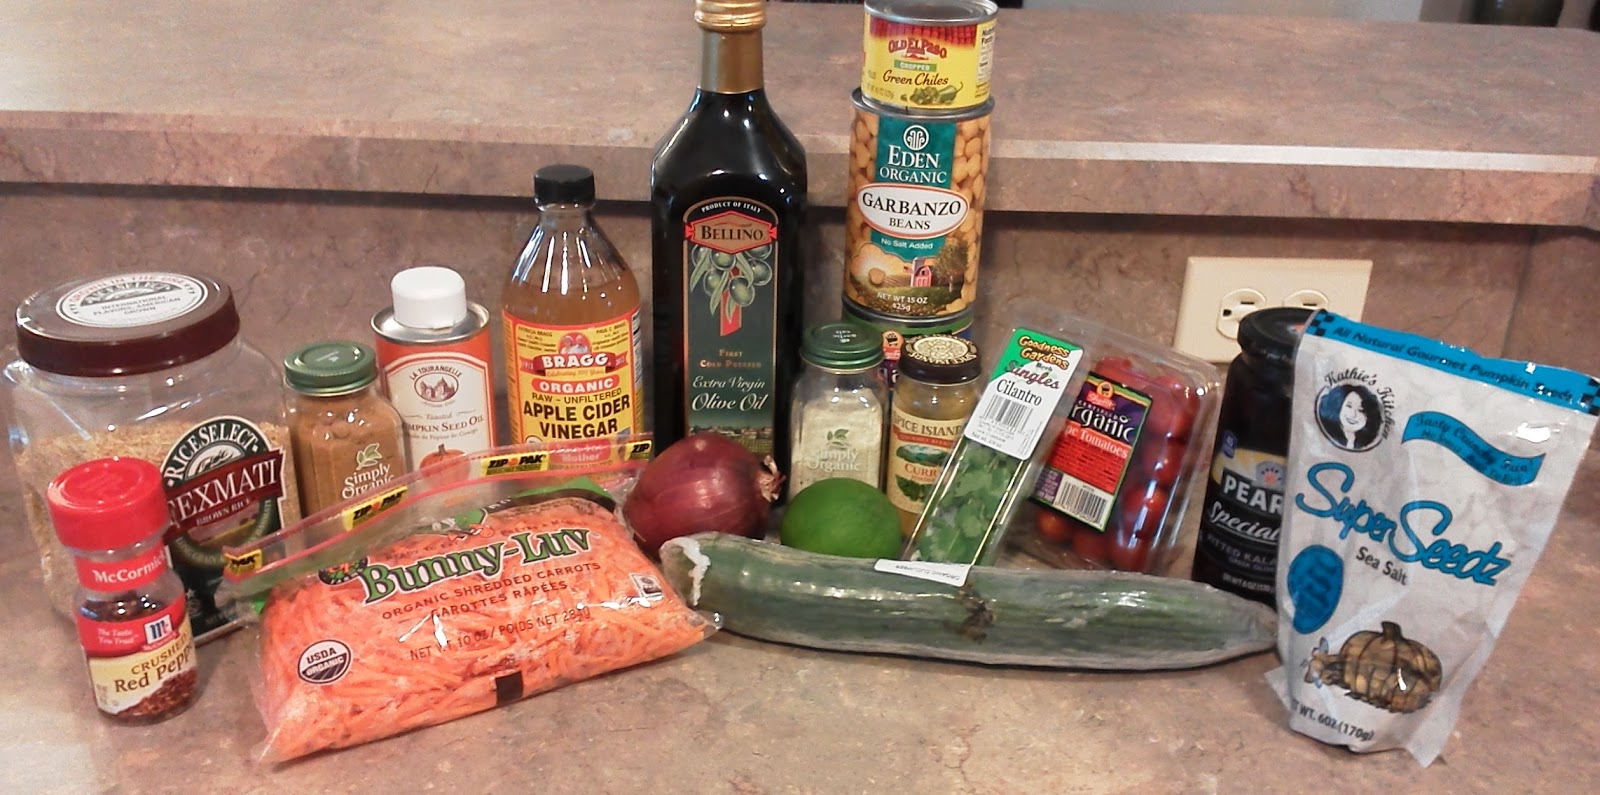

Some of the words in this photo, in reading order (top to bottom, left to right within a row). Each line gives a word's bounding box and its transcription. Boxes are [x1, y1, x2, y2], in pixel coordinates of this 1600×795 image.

[883, 69, 912, 85] Green
[914, 73, 948, 86] Chiles
[887, 144, 940, 169] EDEN
[879, 167, 947, 184] ORGANIC
[701, 202, 731, 213] PRODUCT
[743, 202, 761, 214] ITALY
[862, 192, 961, 216] GARBANZO
[701, 225, 764, 241] BELLINO
[889, 217, 931, 230] BEANS
[881, 237, 891, 246] No
[893, 240, 907, 249] Salt
[909, 241, 934, 250] Added
[877, 292, 891, 300] NET
[893, 295, 905, 303] WT
[907, 296, 916, 304] 15
[916, 297, 928, 305] OZ
[719, 349, 743, 358] FIRST
[1018, 336, 1071, 358] Goodness
[541, 353, 608, 369] BRAGG
[1020, 347, 1070, 371] Gardens
[1333, 327, 1352, 338] All
[1353, 332, 1406, 353] Natural
[1406, 346, 1467, 371] Gourmet
[1469, 364, 1529, 390] Pumpkin
[692, 375, 726, 389] Extra
[728, 376, 766, 393] Virgin
[1004, 360, 1061, 390] Singles
[531, 392, 553, 402] RAW
[564, 388, 622, 404] UNFILTERED
[539, 378, 614, 394] ORGANIC
[996, 379, 1042, 406] Cilantro
[524, 401, 577, 421] APPLE
[583, 394, 630, 420] CIDER
[691, 392, 736, 412] Olive
[739, 393, 769, 412] Oil
[1324, 367, 1378, 387] Kathie's
[1376, 386, 1396, 439] Kitchen
[402, 421, 440, 432] MPKIN
[441, 421, 468, 432] SEED
[540, 418, 618, 439] VINEGAR
[921, 425, 965, 437] ISLAND
[1071, 404, 1136, 443] rganic
[631, 443, 650, 454] ZIP
[1080, 429, 1129, 460] Tomatoes
[488, 458, 508, 469] ZIP
[518, 454, 544, 465] PAK
[807, 458, 861, 472] Organic
[905, 463, 938, 477] CURR
[344, 463, 390, 488] Simply
[1223, 474, 1284, 515] PEAR
[1210, 501, 1280, 541] Special
[1295, 462, 1397, 540] Super
[1389, 500, 1511, 587] Seedz
[362, 528, 592, 605] Bunny-Luv
[1356, 546, 1381, 570] Sea
[1383, 561, 1407, 586] Salt
[382, 592, 449, 619] ORGANIC
[453, 574, 532, 597] SHREDDED
[537, 562, 601, 579] CARROTS
[431, 592, 507, 618] CAROTTES
[410, 645, 432, 661] NET
[457, 635, 471, 648] 10
[499, 619, 534, 635] POIDS
[536, 614, 559, 628] NET
[306, 647, 337, 665] USDA
[115, 673, 150, 693] Red
[156, 644, 192, 681] Pepp
[1300, 704, 1315, 720] WT.
